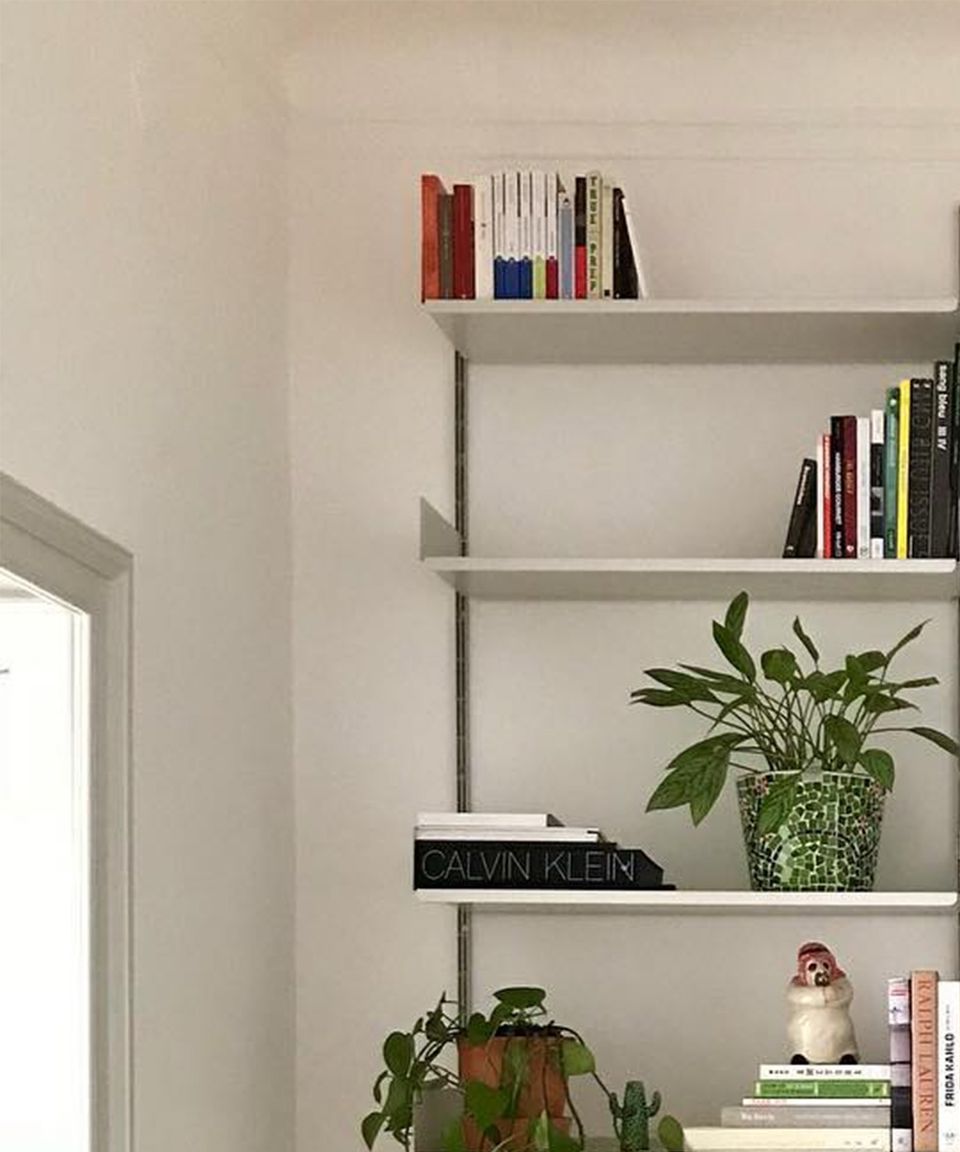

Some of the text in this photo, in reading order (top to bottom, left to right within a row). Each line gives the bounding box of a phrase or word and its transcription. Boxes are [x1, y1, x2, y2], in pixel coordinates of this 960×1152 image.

[937, 393, 948, 418] bleu
[421, 849, 635, 882] CALVIN KLEIN
[917, 979, 935, 1133] RALPH LAUREN
[944, 1033, 955, 1071] KAHLO
[944, 1073, 955, 1107] FRIDA
